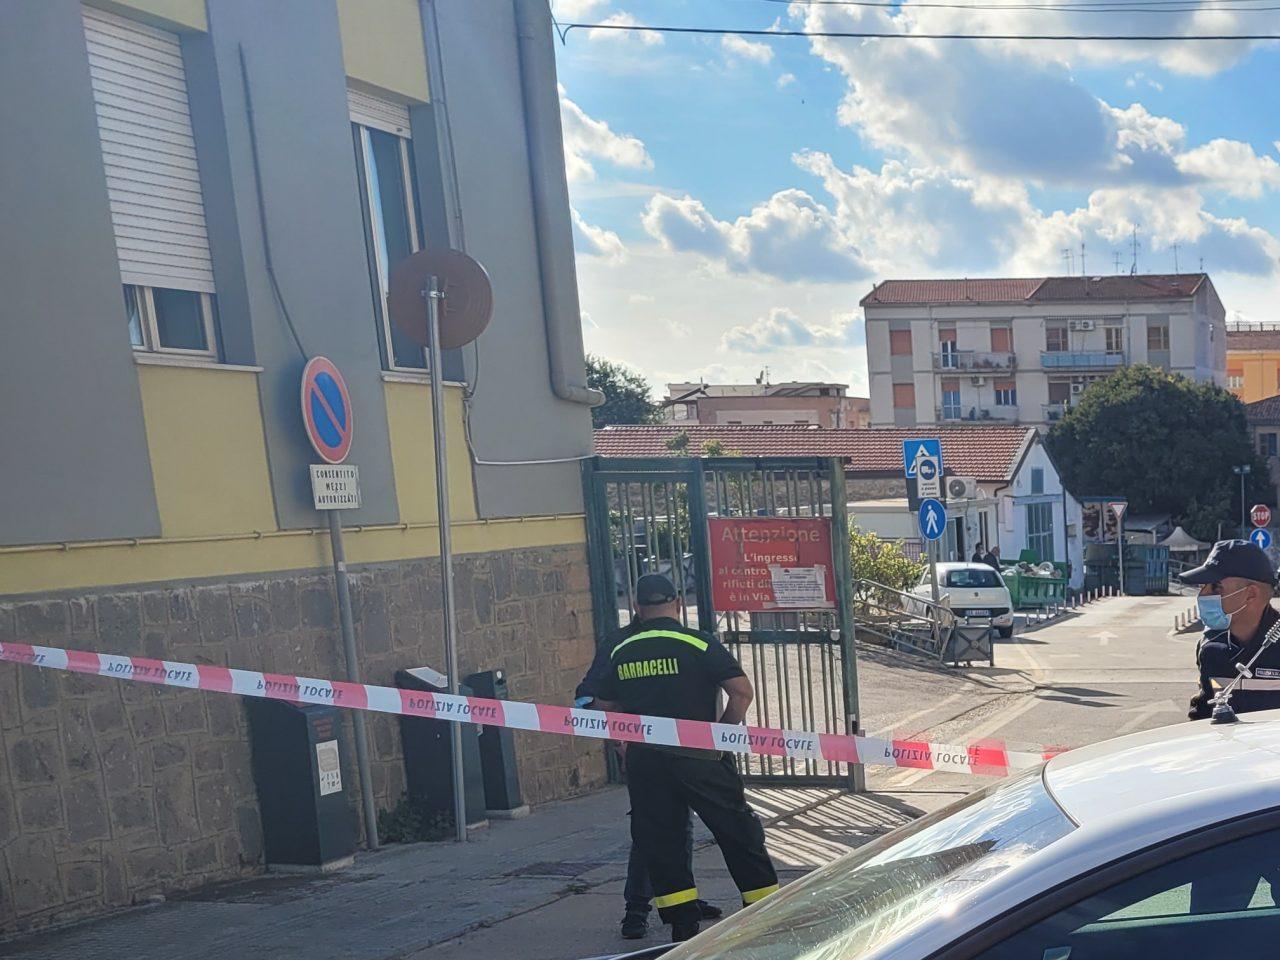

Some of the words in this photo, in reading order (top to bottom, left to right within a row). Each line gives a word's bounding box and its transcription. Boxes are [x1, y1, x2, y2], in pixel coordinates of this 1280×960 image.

[316, 470, 356, 478] CONSENTITO
[326, 482, 347, 491] MEZZI
[318, 494, 357, 504] AUTORIZZATI
[1253, 511, 1269, 520] STOP
[721, 526, 821, 543] Attenzione
[752, 592, 770, 601] Via
[617, 658, 680, 681] BARRACELLI
